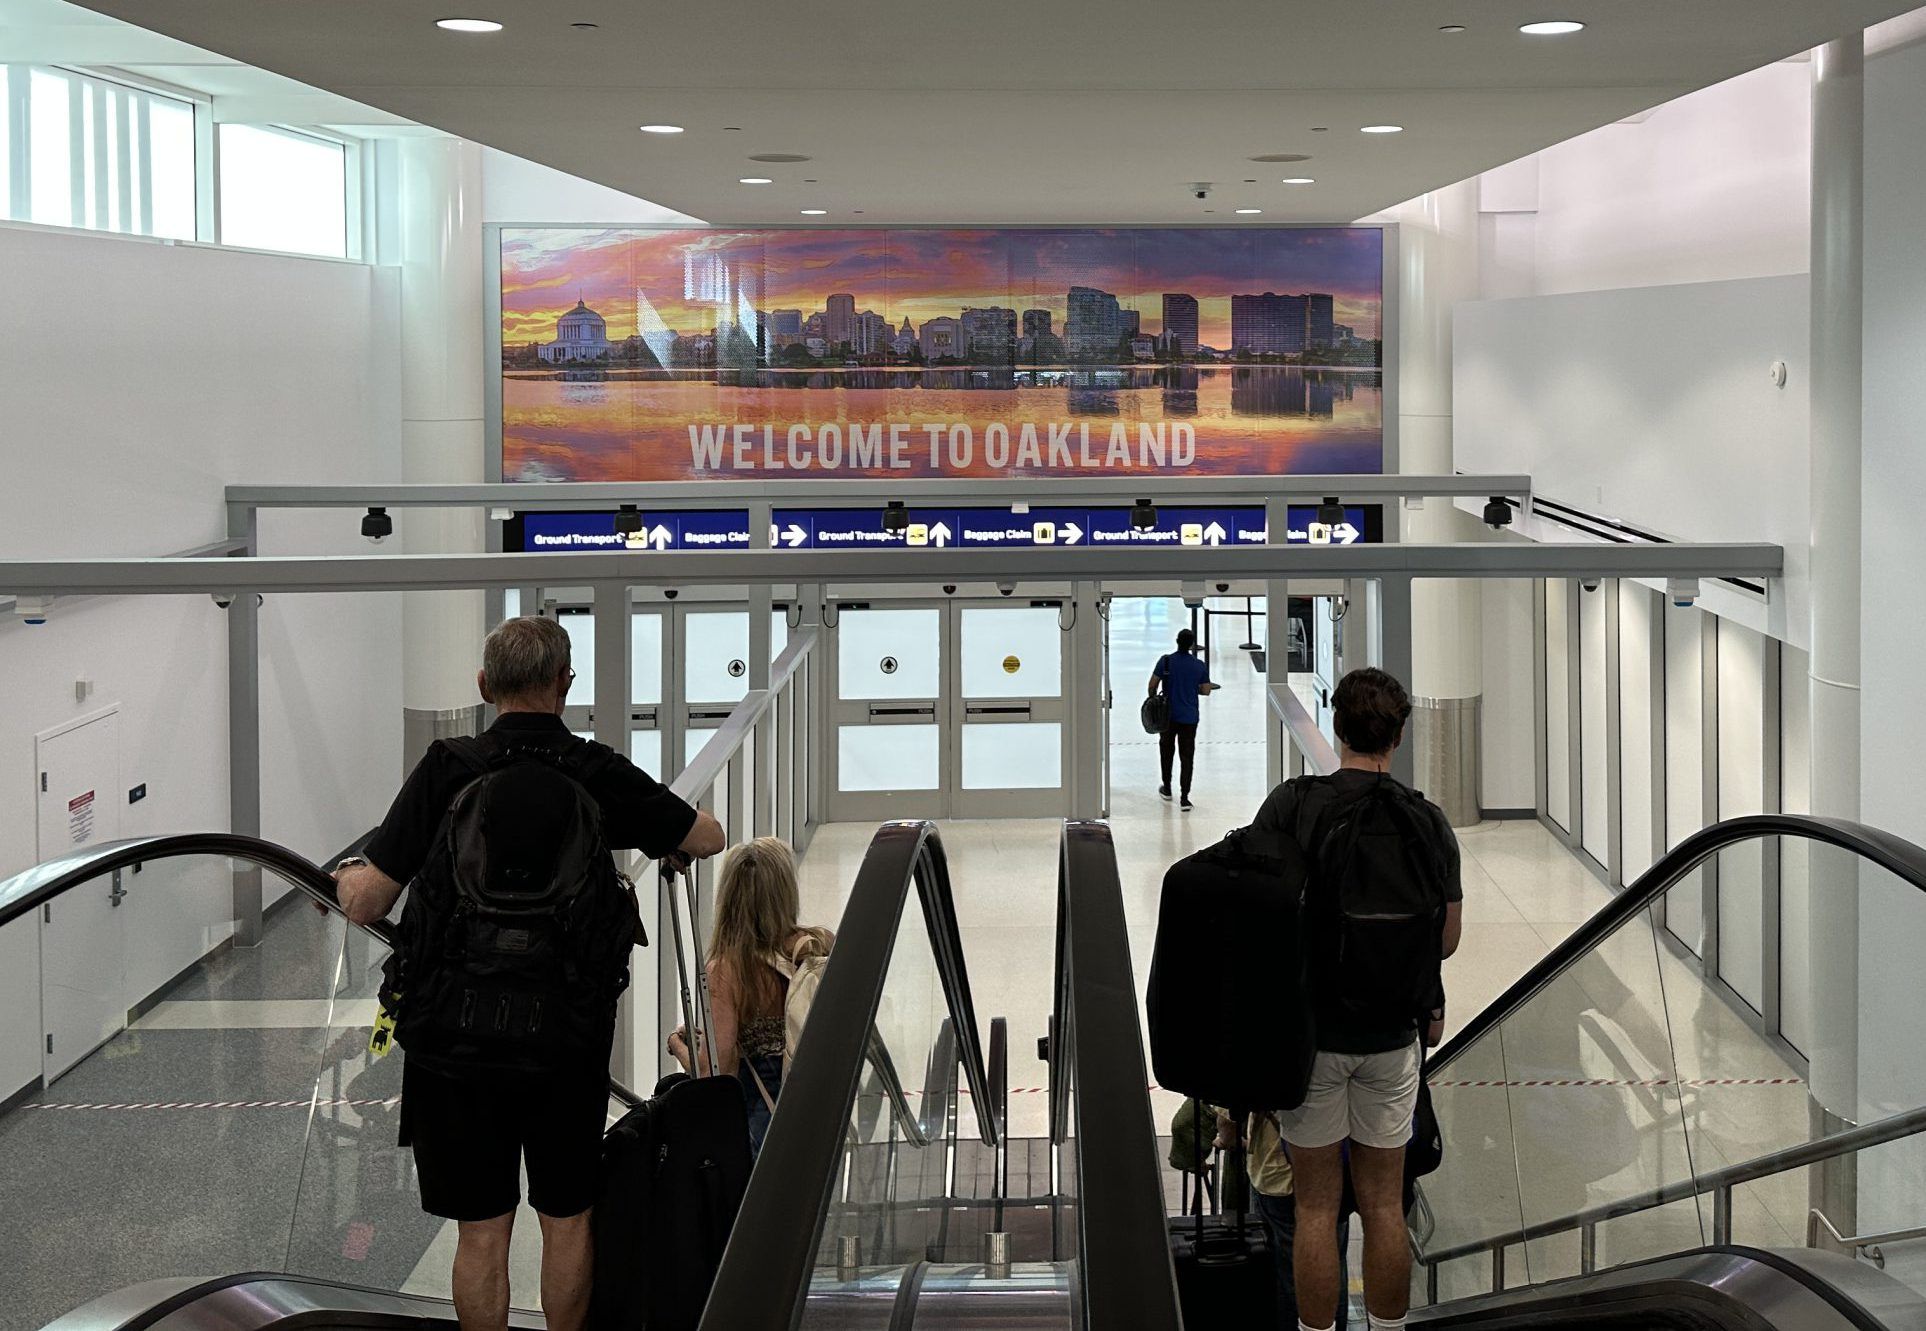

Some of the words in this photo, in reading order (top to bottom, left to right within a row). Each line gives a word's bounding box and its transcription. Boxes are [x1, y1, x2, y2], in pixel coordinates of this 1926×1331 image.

[688, 424, 911, 470] WELCOME
[922, 423, 973, 468] TO
[985, 422, 1196, 468] OAKLAND
[534, 534, 572, 545] Ground
[685, 532, 727, 544] Baggage
[818, 530, 854, 541] Ground
[964, 530, 1005, 541] Baggage
[1005, 529, 1032, 539] Claim
[1093, 530, 1129, 540] Ground
[1130, 530, 1179, 542] Transport
[1287, 529, 1307, 539] laim
